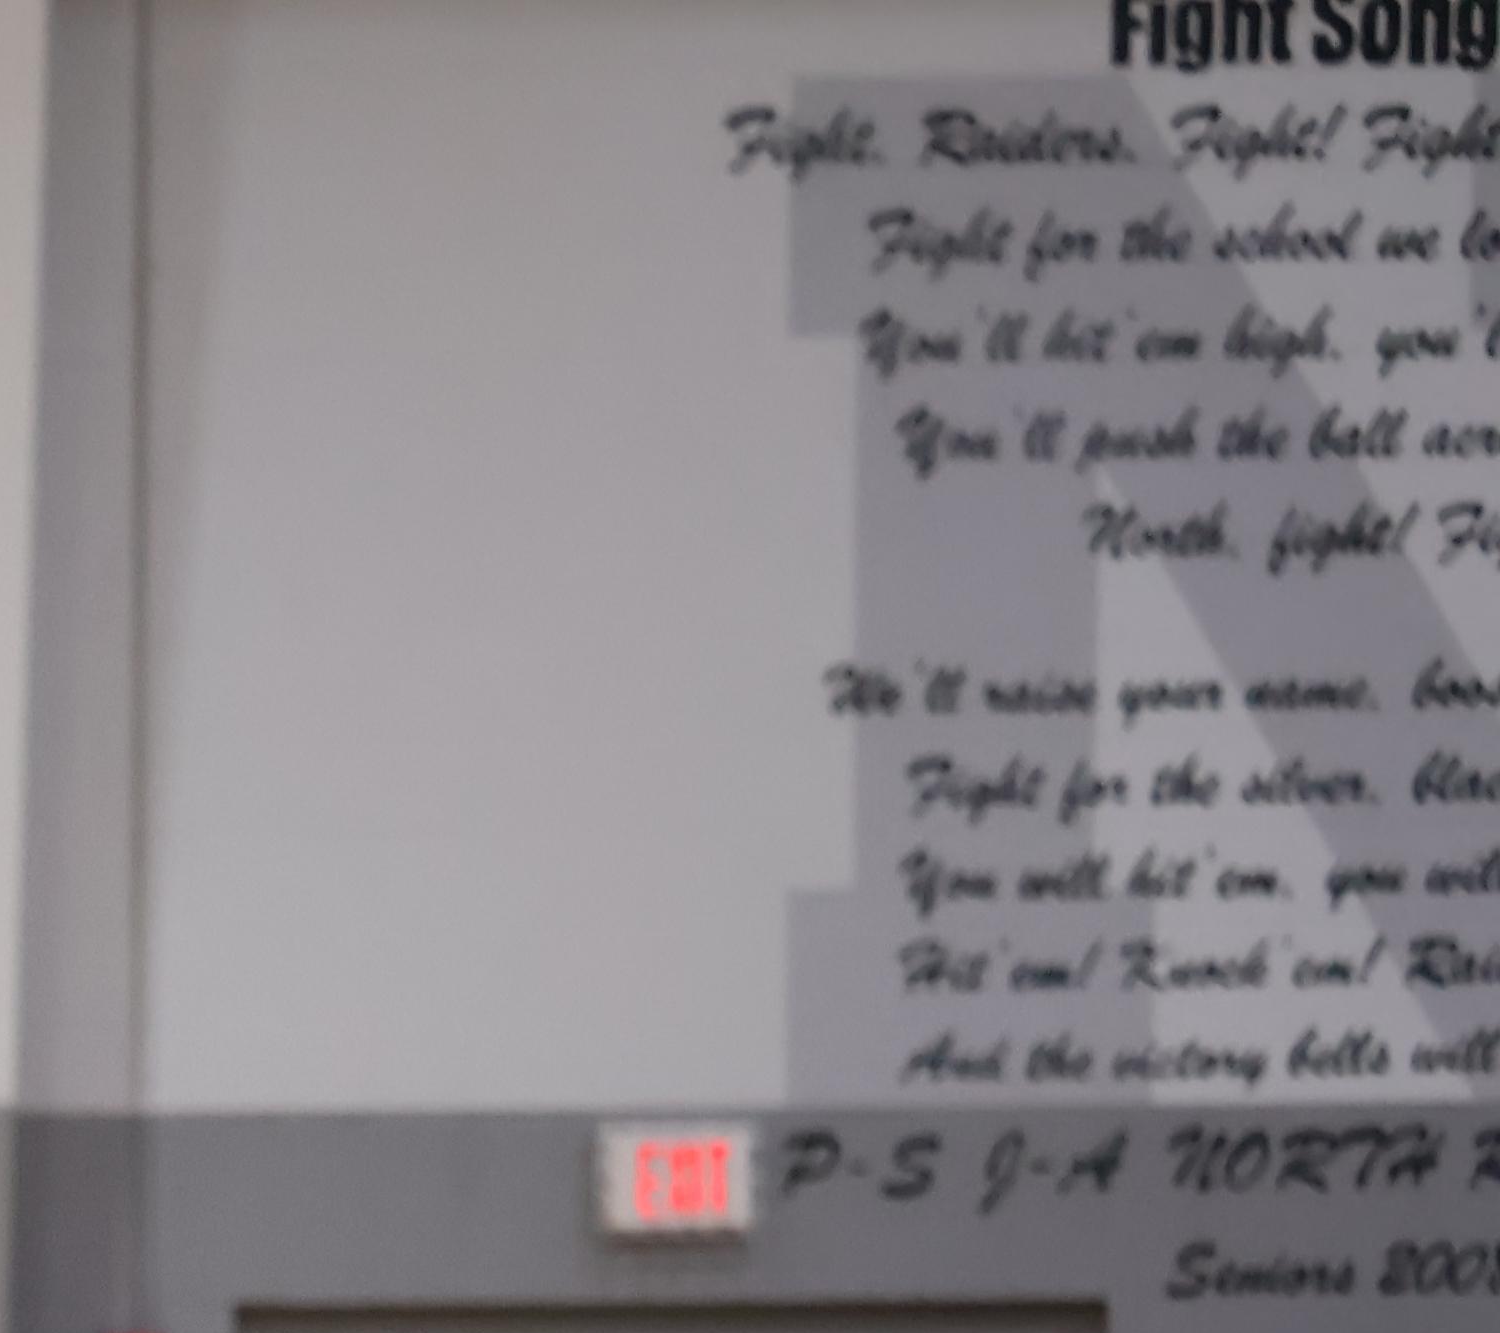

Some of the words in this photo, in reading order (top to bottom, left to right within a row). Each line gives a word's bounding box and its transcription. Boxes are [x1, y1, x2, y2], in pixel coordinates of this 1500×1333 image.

[1108, 0, 1292, 72] Fight
[1312, 0, 1500, 70] Song
[868, 205, 1010, 283] Fight
[1020, 208, 1098, 284] for
[1119, 204, 1195, 263] the
[1212, 200, 1365, 263] school
[1376, 224, 1440, 263] we
[1041, 308, 1114, 364] hit
[1073, 405, 1200, 478] push
[1216, 405, 1290, 463] the
[1307, 405, 1410, 462] ball
[1117, 678, 1224, 733] your
[903, 752, 1048, 828] Fight
[1056, 754, 1131, 826] for
[1150, 752, 1222, 806] the
[898, 845, 997, 920] You
[1017, 850, 1111, 898] will
[1125, 845, 1198, 898] hit
[1324, 864, 1407, 912] you
[898, 935, 992, 992] Hit
[902, 1032, 1006, 1082] And
[1024, 1032, 1096, 1082] the
[1110, 1040, 1272, 1096] victory
[1287, 1027, 1393, 1080] bells
[634, 1140, 732, 1220] EXIT
[1167, 1122, 1450, 1195] NORTH
[1165, 1240, 1356, 1300] Seniors
